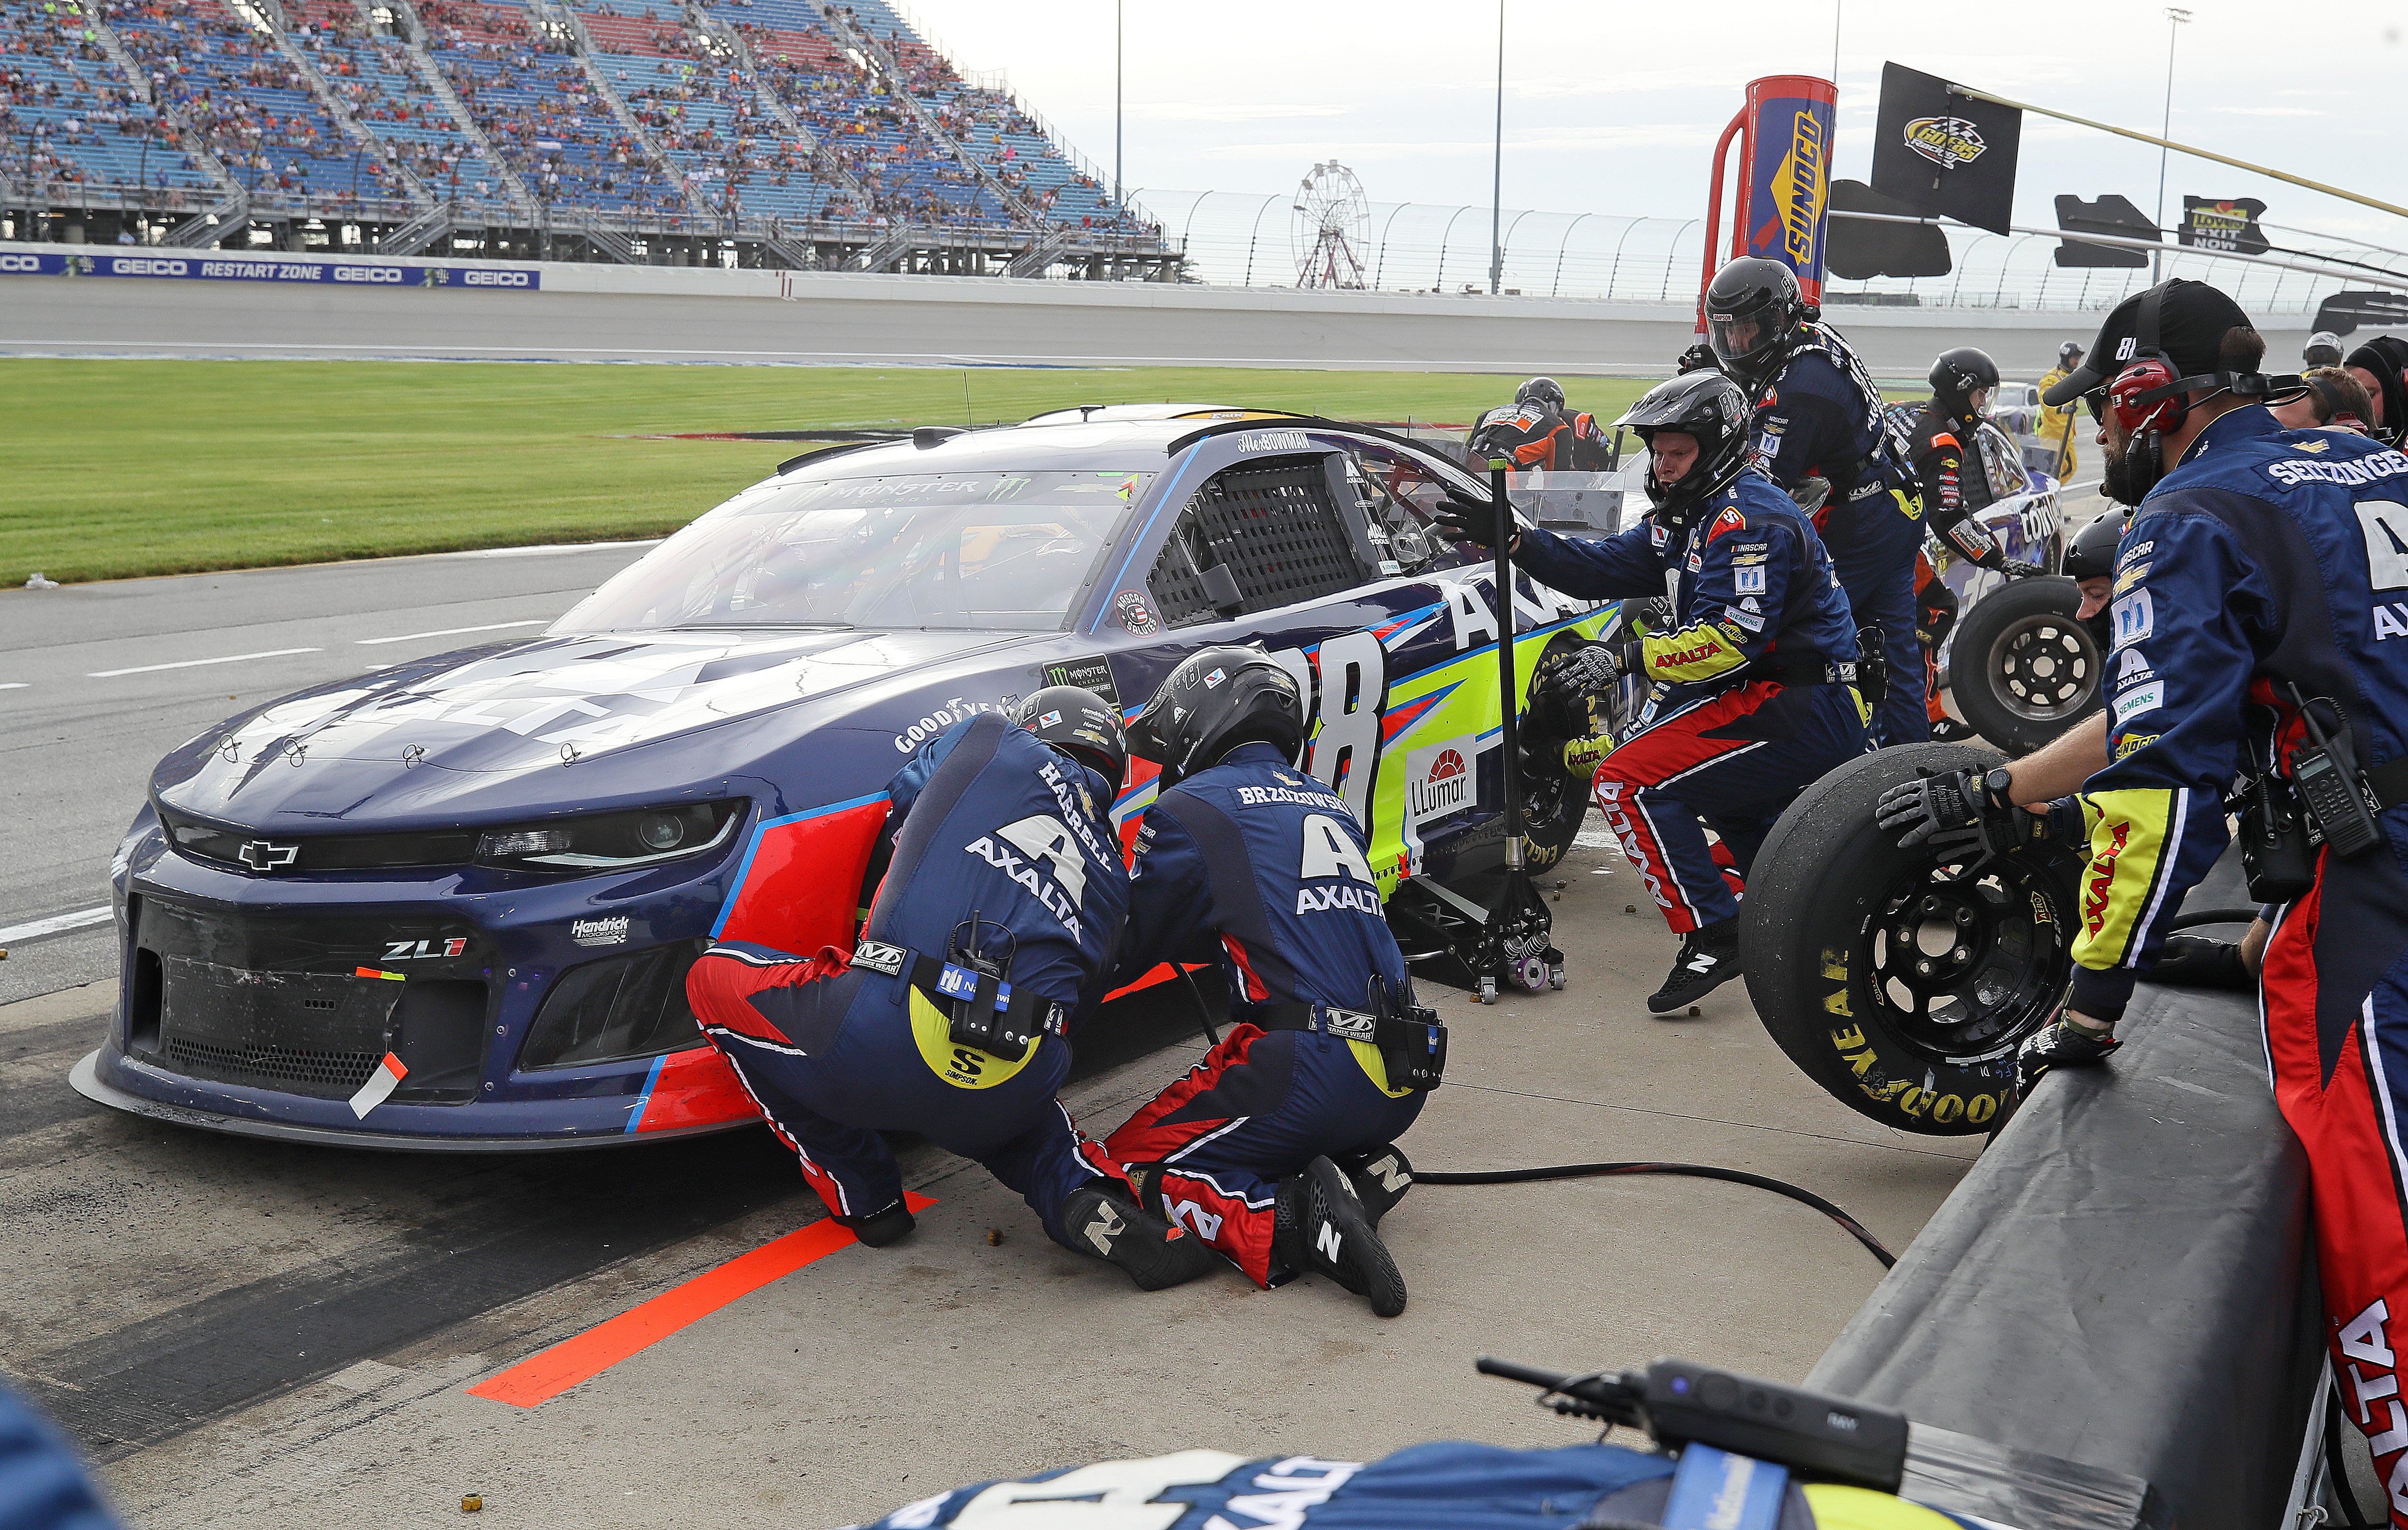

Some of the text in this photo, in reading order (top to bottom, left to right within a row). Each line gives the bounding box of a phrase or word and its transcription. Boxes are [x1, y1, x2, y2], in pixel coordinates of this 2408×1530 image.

[1788, 117, 1821, 258] SUNOCO
[2193, 237, 2237, 250] NOW
[2195, 228, 2241, 240] EXIT
[112, 259, 188, 275] GEICO
[201, 262, 322, 280] RESTART ZONE
[334, 267, 402, 282] GEICO
[465, 271, 529, 286] GEICO
[1718, 385, 1740, 420] 88
[1769, 415, 1789, 425] NASCAR
[1263, 431, 1310, 451] BOWMAN
[1740, 543, 1768, 552] NASCAR
[1953, 526, 1977, 550] Systems
[1965, 530, 1988, 552] Schluter
[1117, 593, 1145, 611] NASCAR
[1126, 617, 1157, 636] SALUTES
[1728, 611, 1759, 627] SIEMENS
[1719, 622, 1747, 644] SUNOCO
[1655, 640, 1722, 668] AXALTA
[1069, 665, 1108, 680] MONSTER
[1078, 677, 1105, 686] ENERGY
[2117, 670, 2155, 692] AXALTA
[1098, 683, 1111, 691] SERIES
[1080, 706, 1106, 720] Hendrick
[2119, 692, 2154, 717] SIEMENS
[894, 701, 1012, 754] GOODYEA
[1083, 721, 1103, 732] Harrell
[1182, 740, 1199, 767] Nationwide
[1568, 749, 1601, 766] AXALTA
[1411, 776, 1467, 818] LLumar
[1038, 760, 1112, 873] HARRELL
[1597, 780, 1673, 909] AXALTA
[964, 836, 1084, 945] AXALTA
[2085, 821, 2130, 946] AXALTA
[1296, 885, 1386, 922] AXALTA
[2034, 897, 2048, 919] AERO
[570, 915, 630, 938] Hendrick
[581, 928, 628, 938] MOTORSPORTS
[380, 937, 467, 961] ZL1
[875, 963, 900, 973] WEAR
[1310, 1020, 1373, 1040] MHANIX WEAR
[944, 1069, 978, 1086] SIMPSON
